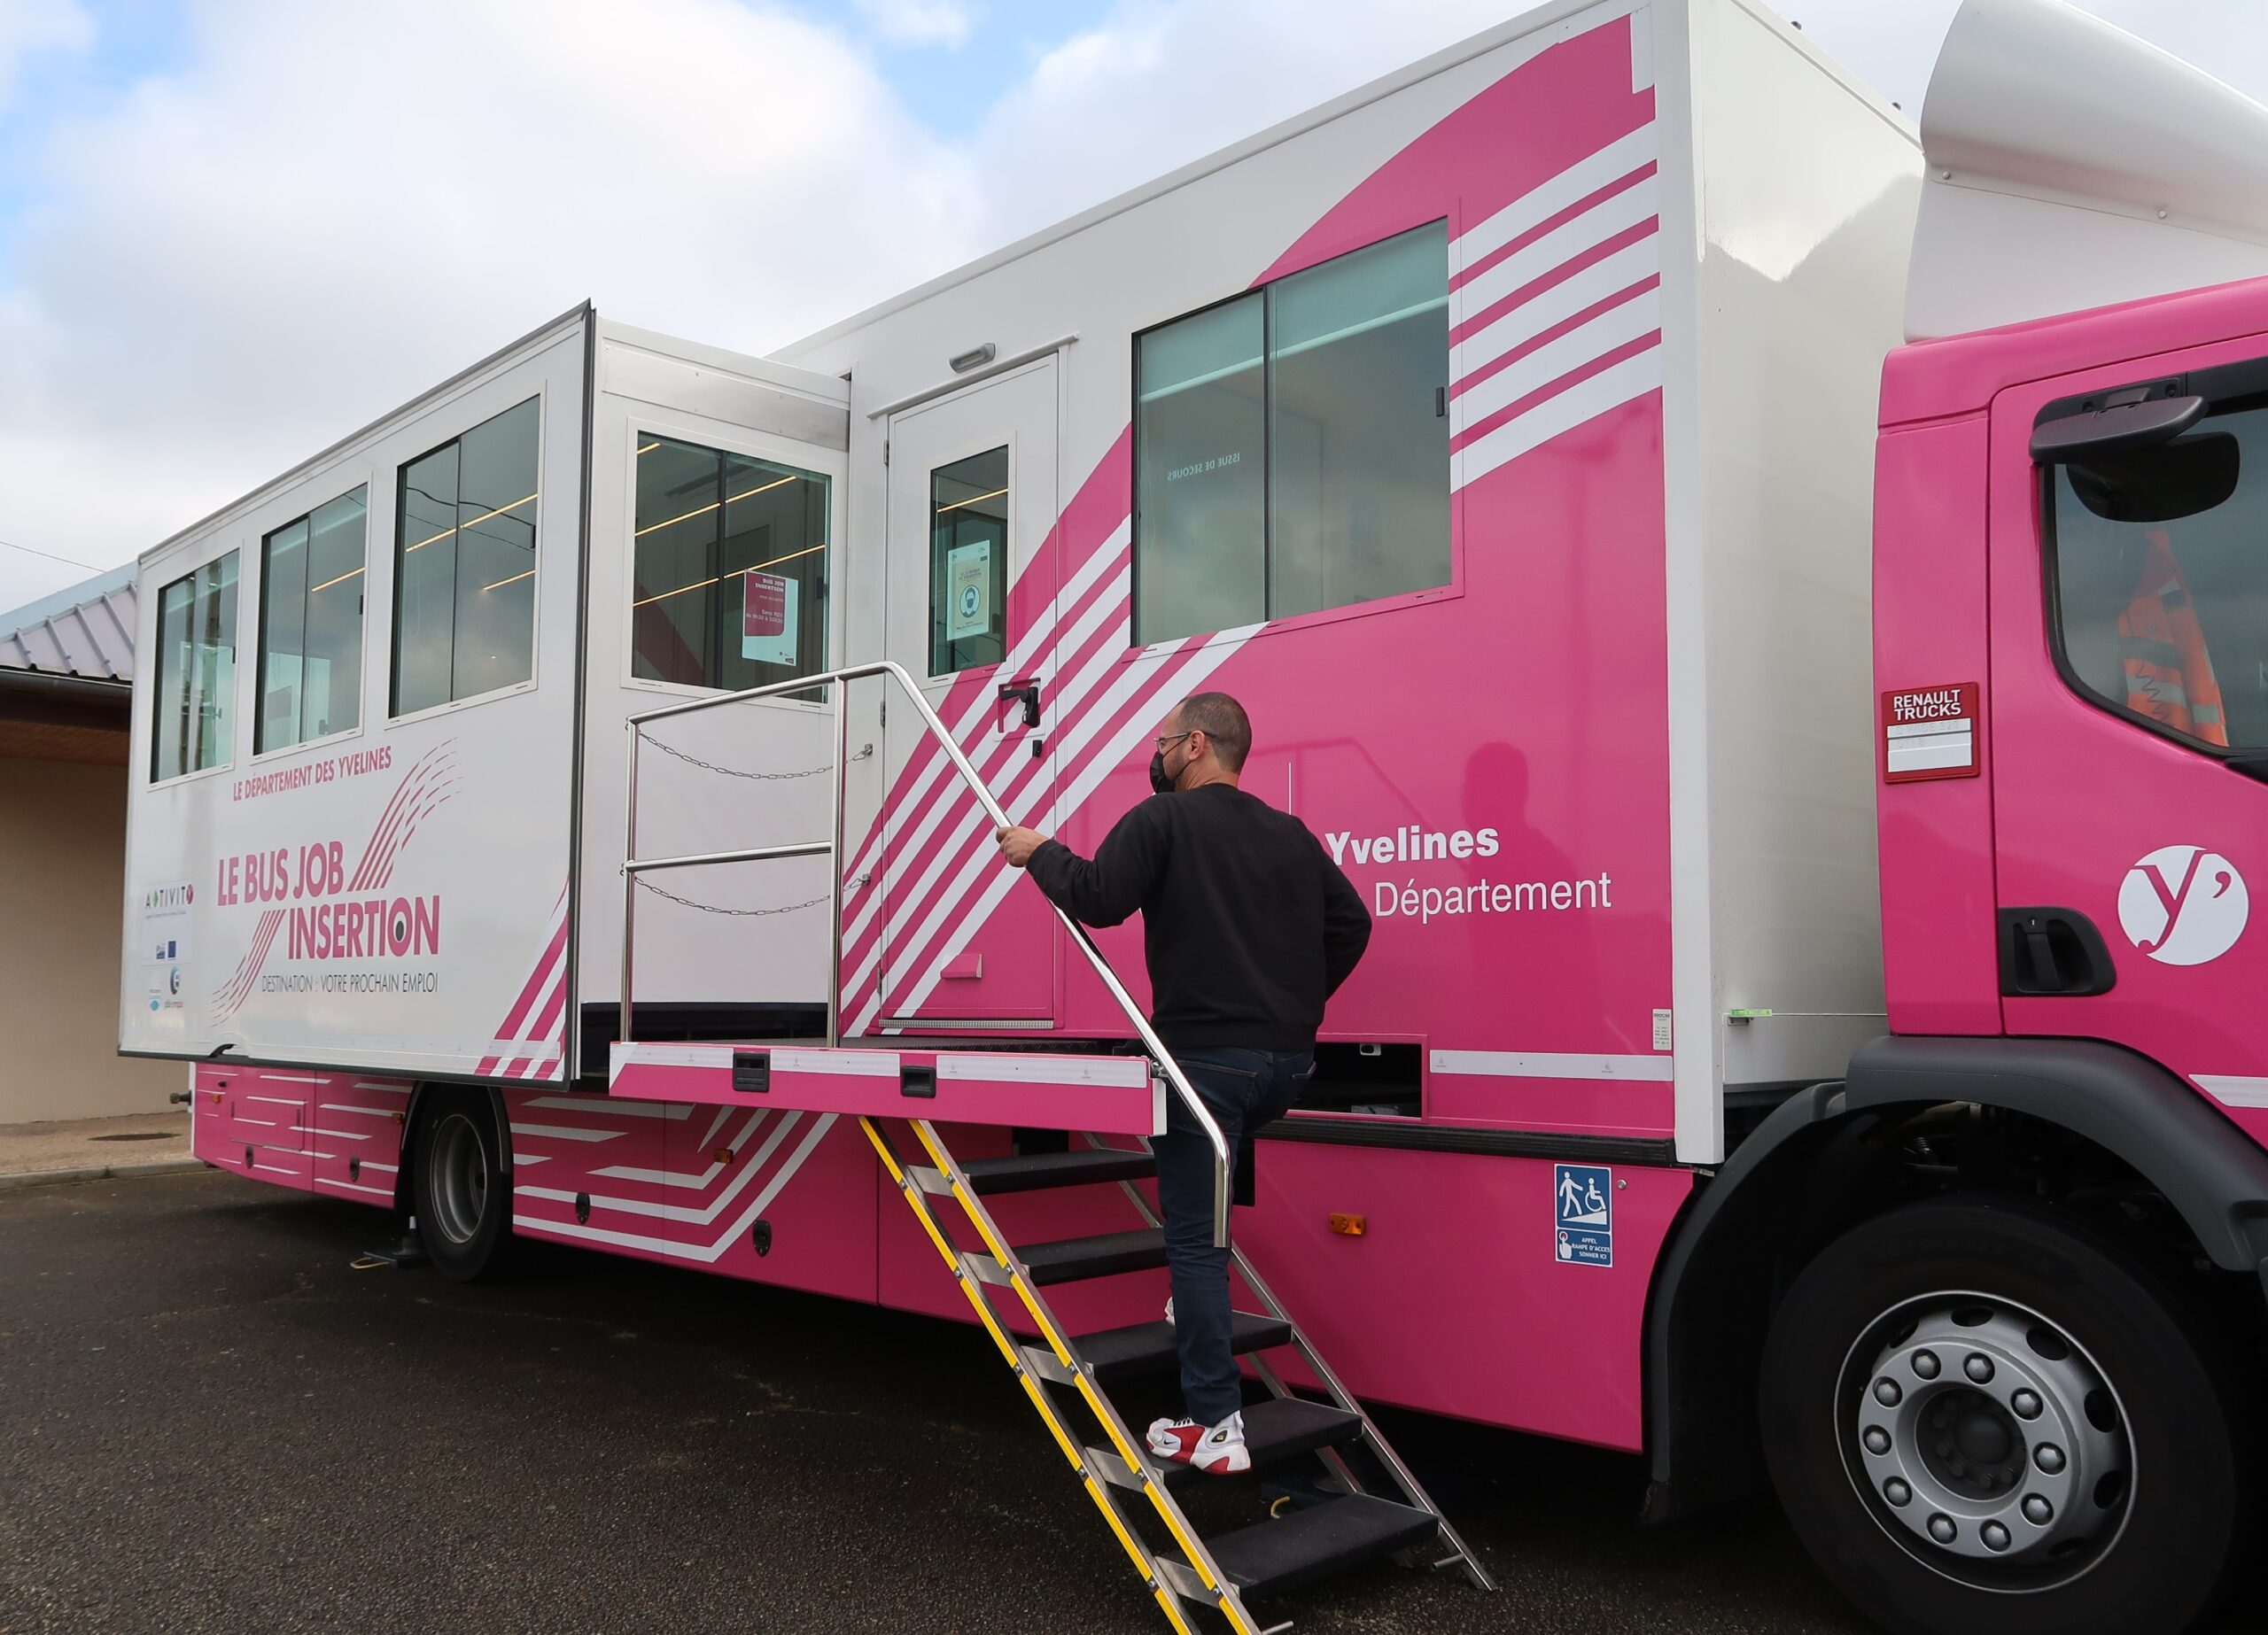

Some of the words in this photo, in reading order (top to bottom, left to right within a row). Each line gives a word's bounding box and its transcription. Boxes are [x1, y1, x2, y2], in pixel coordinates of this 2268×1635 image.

[1893, 689, 1961, 709] RENAULT
[1894, 702, 1961, 721] TRUCKS
[233, 781, 242, 801] LE
[245, 764, 312, 799] DÉPARTEMENT
[315, 759, 335, 784] DES
[338, 746, 392, 779] YVELINES
[1324, 825, 1500, 866] Yvelines
[218, 856, 239, 906] LE
[245, 848, 289, 903] BUS
[292, 841, 344, 900] JOB
[1375, 872, 1612, 925] Département
[288, 895, 440, 959] INSERTION
[262, 974, 314, 993] DESTINATION
[322, 974, 347, 993] VOTRE
[351, 973, 400, 993] PROCHAIN
[402, 972, 439, 993] EMPLOI
